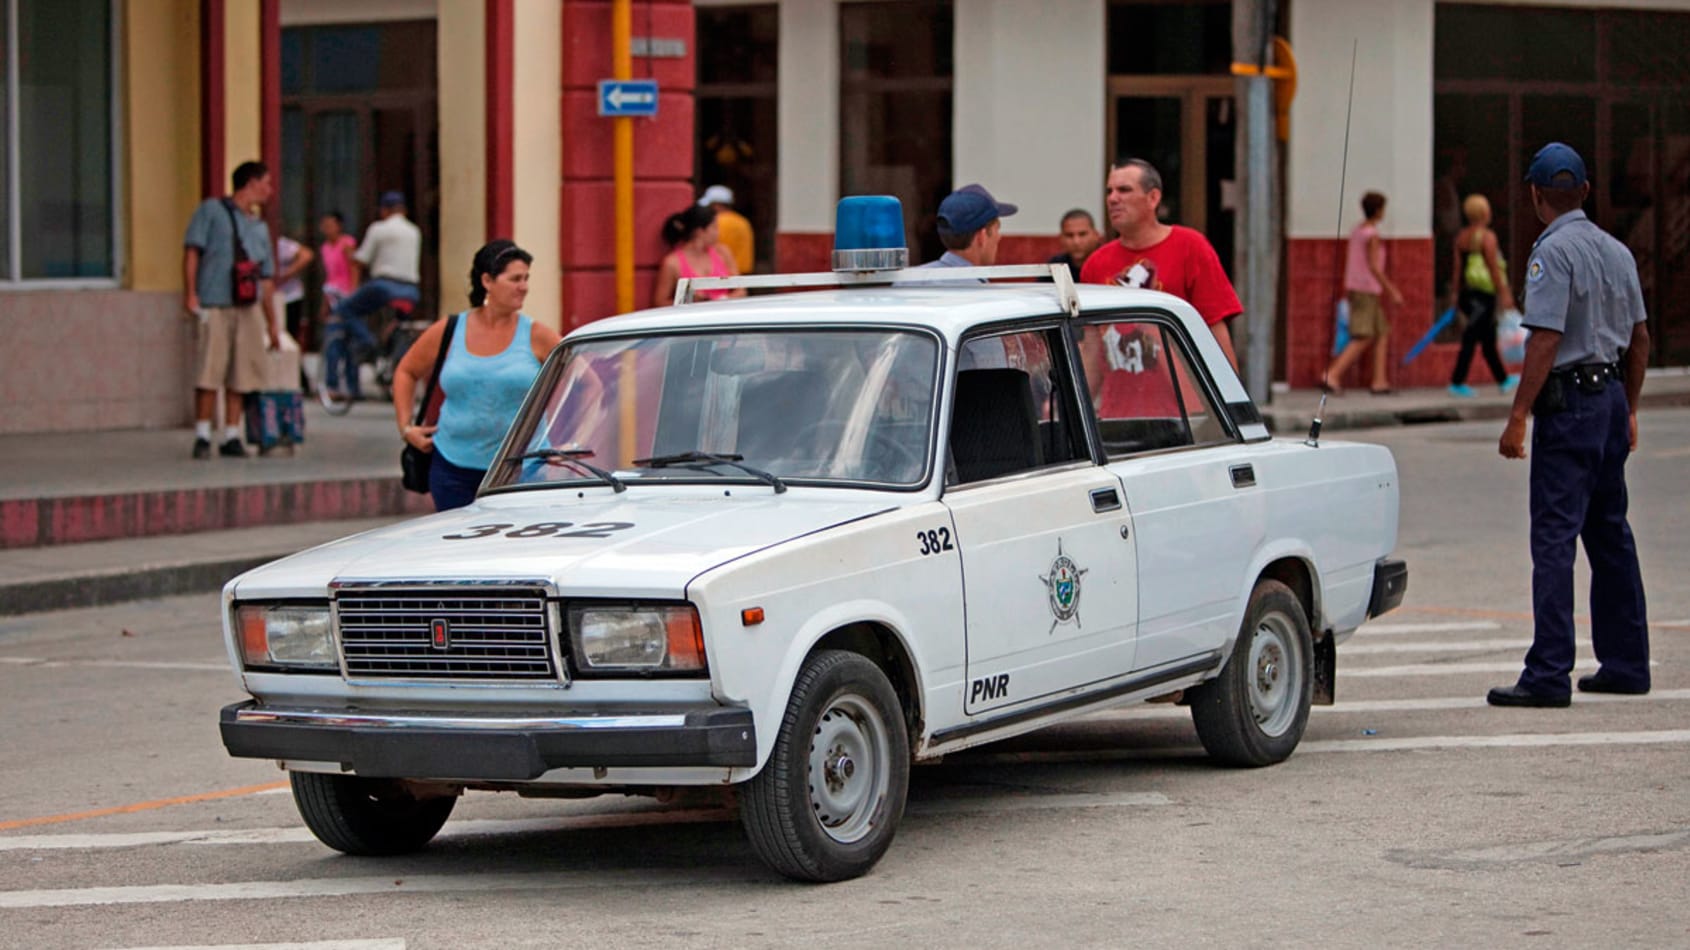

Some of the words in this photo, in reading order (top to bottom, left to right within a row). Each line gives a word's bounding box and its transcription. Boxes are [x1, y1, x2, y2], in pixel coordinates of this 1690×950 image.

[442, 522, 636, 540] 382
[917, 526, 954, 555] 382
[970, 673, 1009, 704] PNR
